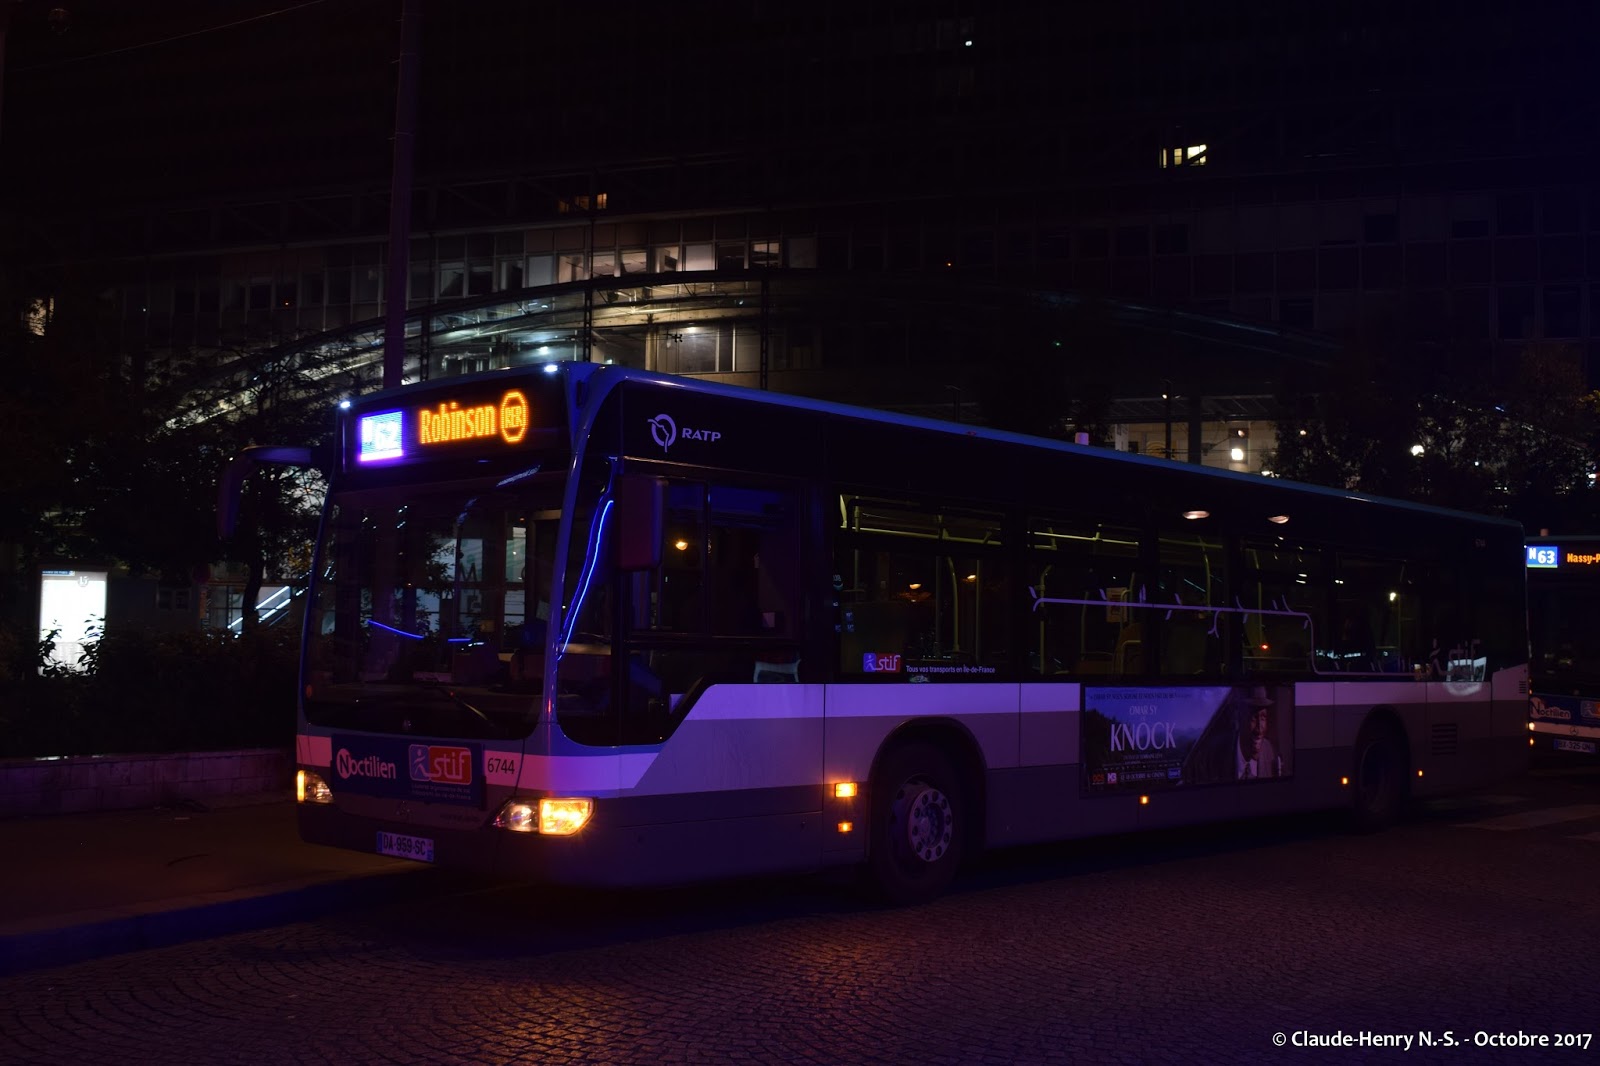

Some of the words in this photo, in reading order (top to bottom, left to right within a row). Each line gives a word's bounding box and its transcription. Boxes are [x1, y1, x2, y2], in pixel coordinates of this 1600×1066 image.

[419, 402, 497, 444] Robinson
[682, 427, 721, 442] RATP
[877, 654, 901, 671] stif
[906, 665, 918, 673] Tous
[930, 666, 955, 674] transports
[1129, 706, 1148, 716] OMAR
[1149, 705, 1158, 715] SY
[1111, 723, 1176, 752] KNOCK
[338, 749, 396, 779] Noctilien
[433, 751, 471, 780] stif
[487, 757, 515, 774] 6744
[383, 834, 426, 856] DA-959-SC
